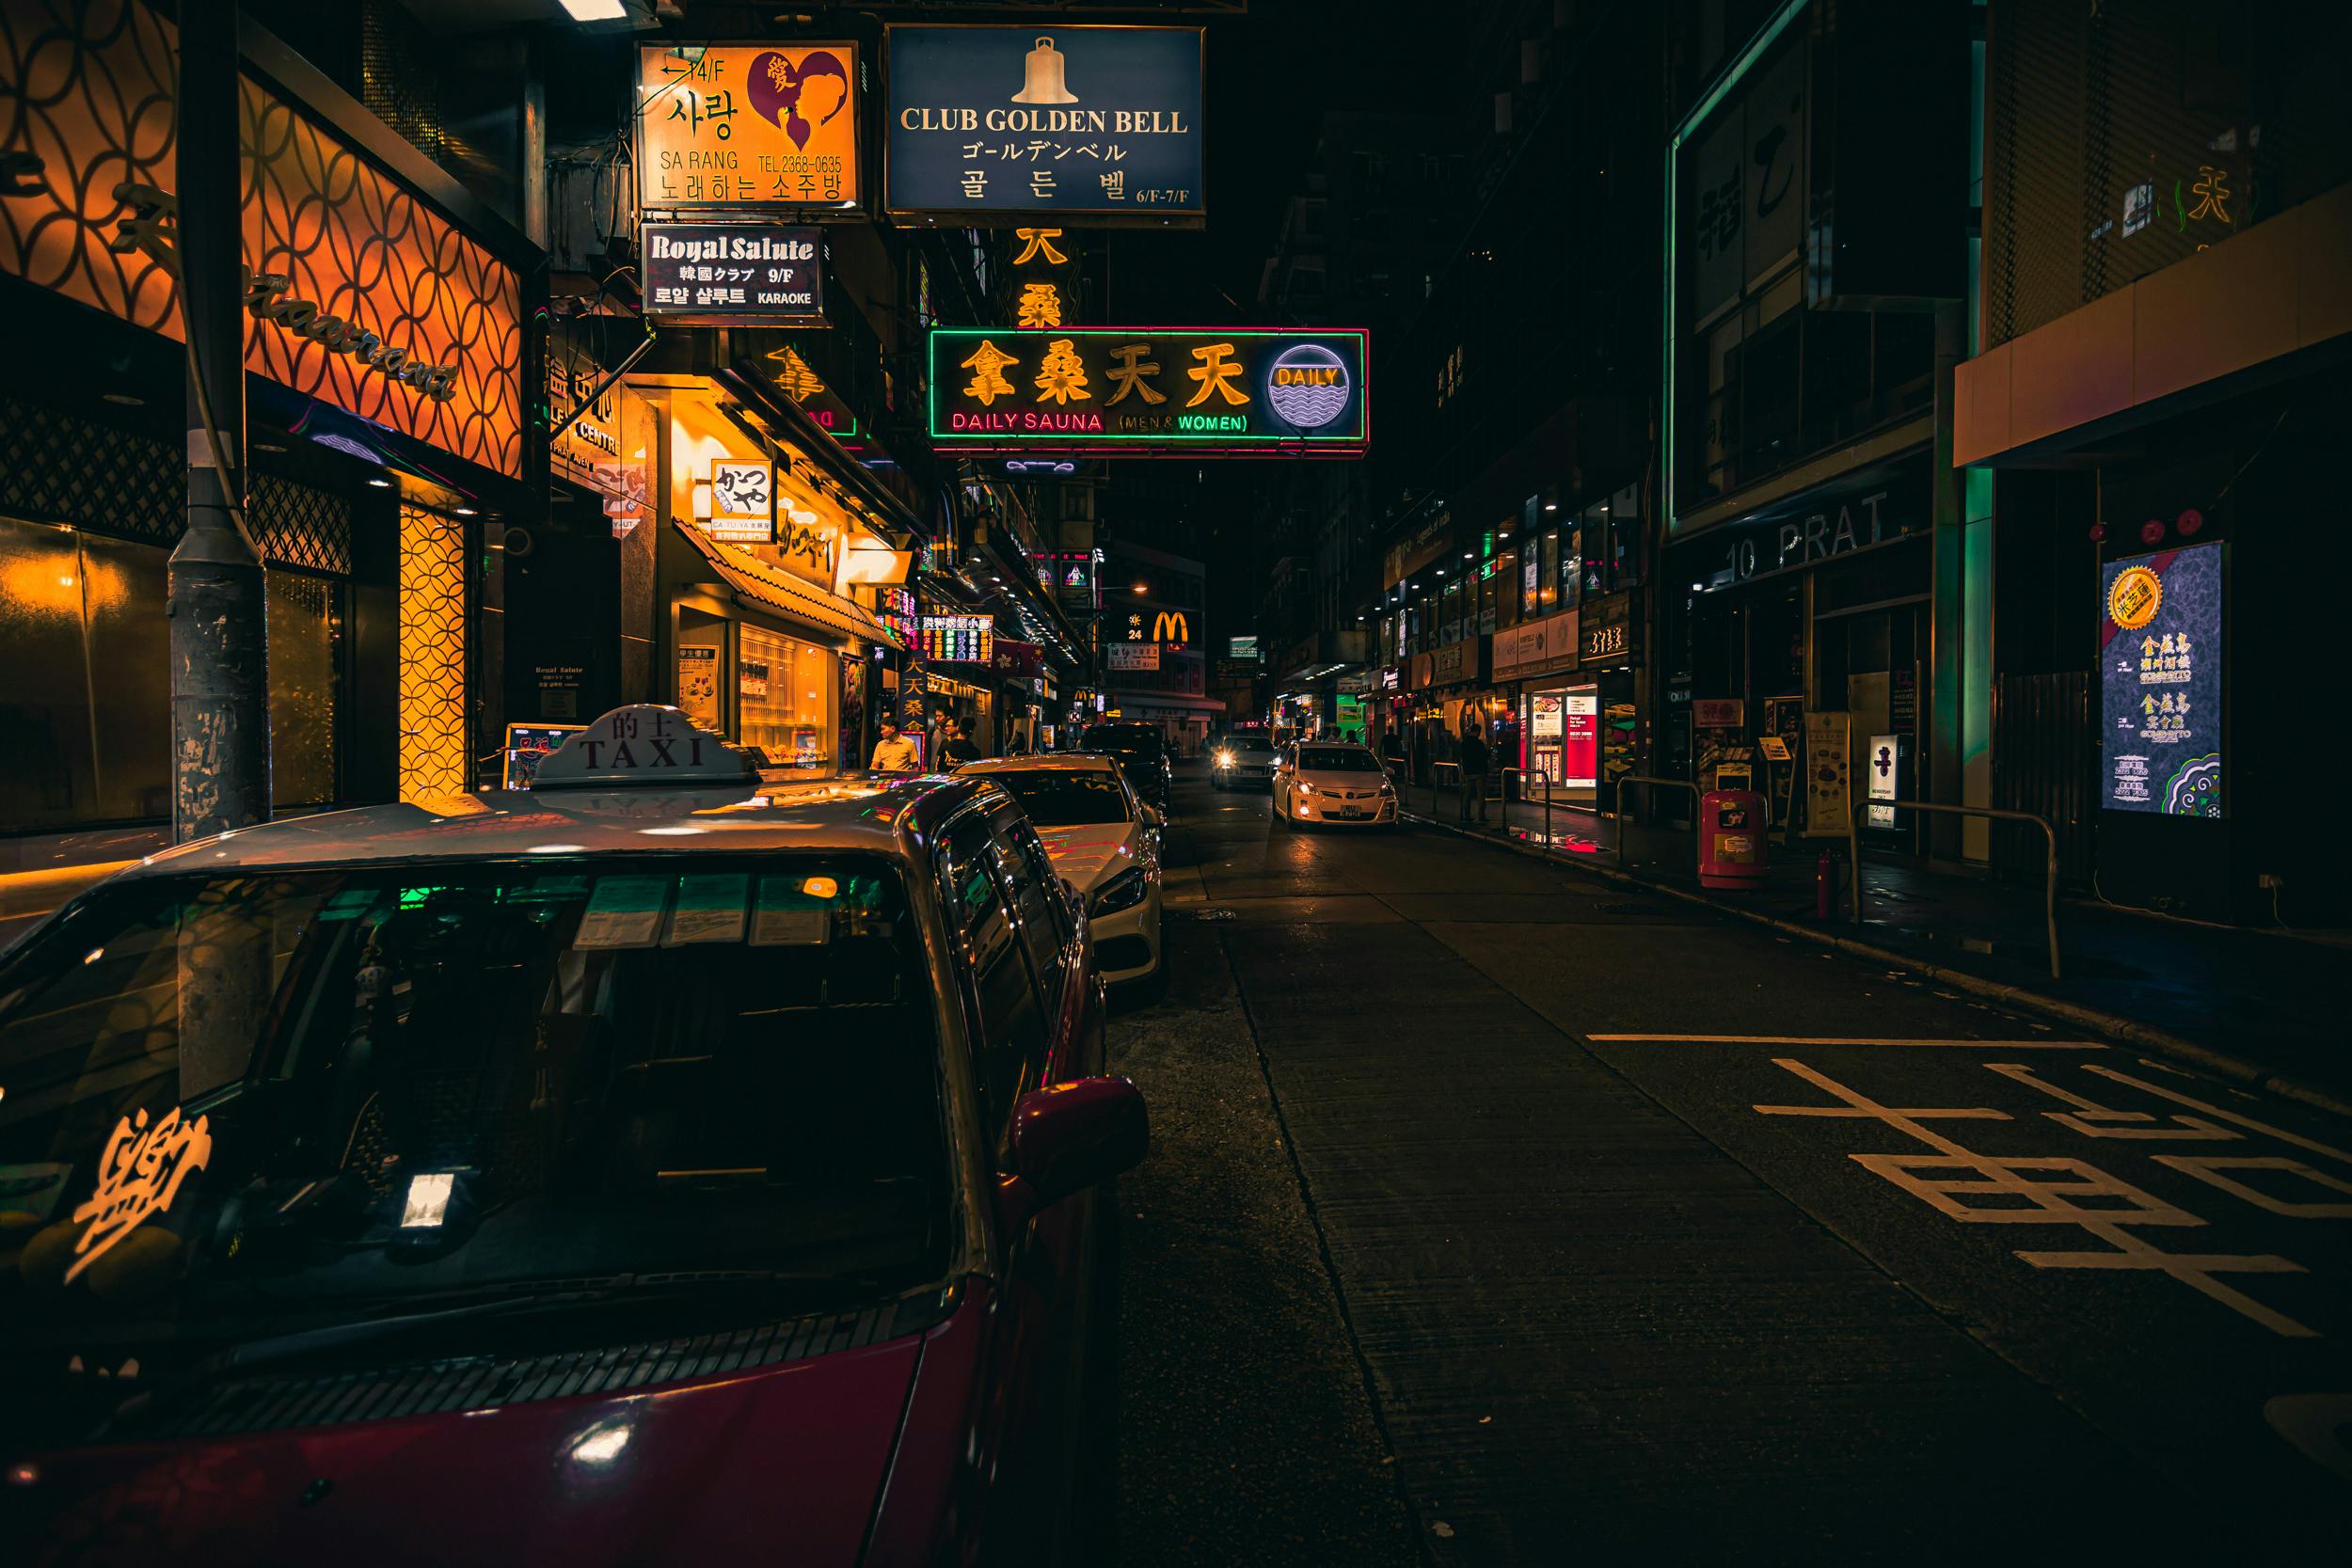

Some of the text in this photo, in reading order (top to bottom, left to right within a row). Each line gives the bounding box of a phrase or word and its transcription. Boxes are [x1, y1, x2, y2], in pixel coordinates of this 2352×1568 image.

[689, 59, 724, 83] 14/F
[767, 55, 798, 93] 愛
[667, 89, 738, 140] 사랑
[900, 107, 1188, 134] CLUB GOLDEN BELL
[660, 150, 738, 170] SA RANG
[962, 140, 1127, 163] ゴールデンベル
[758, 155, 842, 173] TEL 2368-0635
[661, 174, 842, 201] 노래하는 소주방
[1136, 189, 1189, 204] 6/F-7/F
[651, 235, 814, 263] Royal Salute
[679, 265, 794, 283] 韓國クラブ 9/F
[655, 287, 812, 305] 로얄 샬루트 KARAOKE
[1277, 368, 1339, 386] DAILY
[952, 412, 1019, 431] DAILY
[1024, 412, 1104, 432] SAUNA
[1178, 414, 1248, 433] WOMEN)
[580, 421, 620, 456] CENTRE
[1725, 491, 1888, 583] 10 PRAT
[1128, 629, 1143, 641] 24
[612, 712, 674, 740] 的士
[579, 737, 705, 769] TAXI
